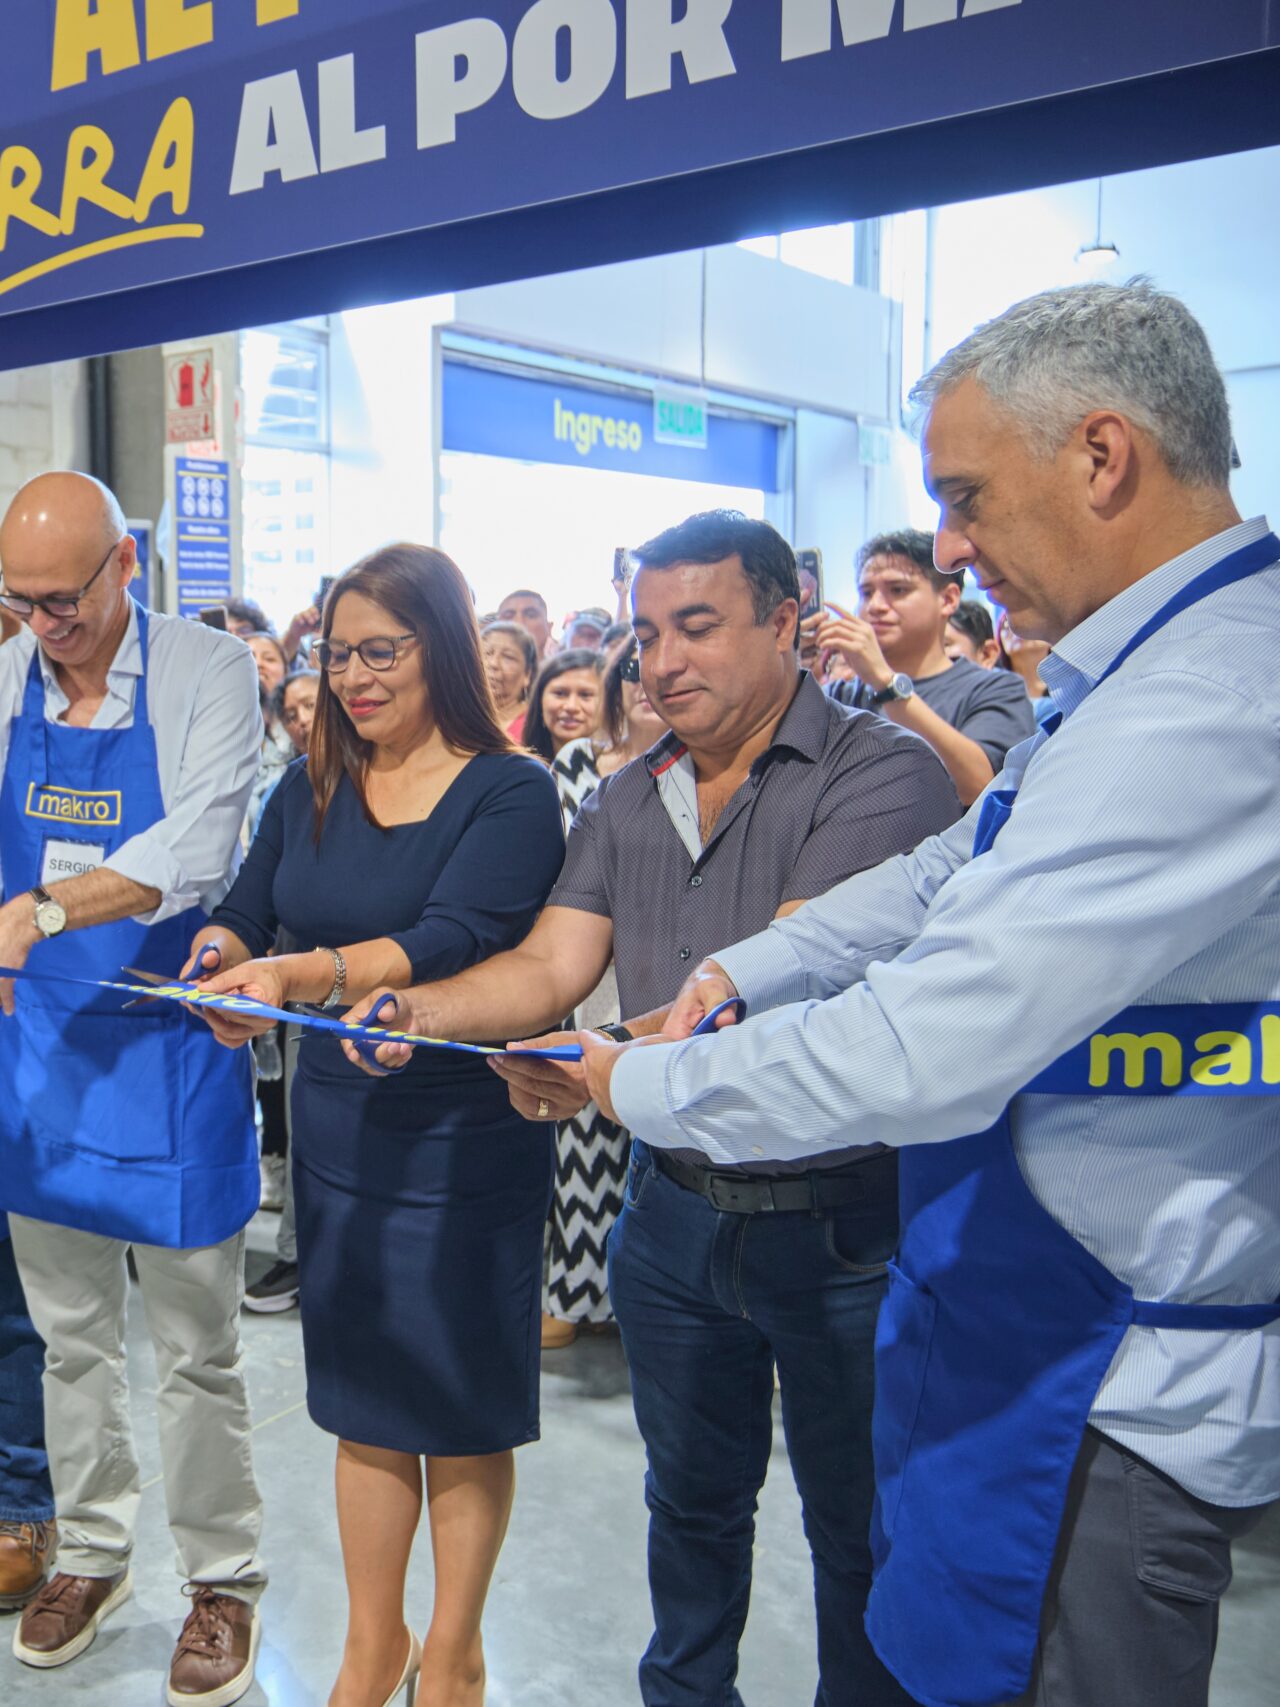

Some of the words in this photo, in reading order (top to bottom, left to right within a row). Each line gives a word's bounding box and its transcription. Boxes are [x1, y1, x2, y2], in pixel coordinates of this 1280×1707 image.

[229, 52, 387, 196] AL
[416, 0, 737, 150] POR
[553, 398, 642, 455] Ingreso
[658, 400, 704, 435] SALIDA
[38, 794, 110, 820] makro
[49, 858, 97, 875] SERGIO
